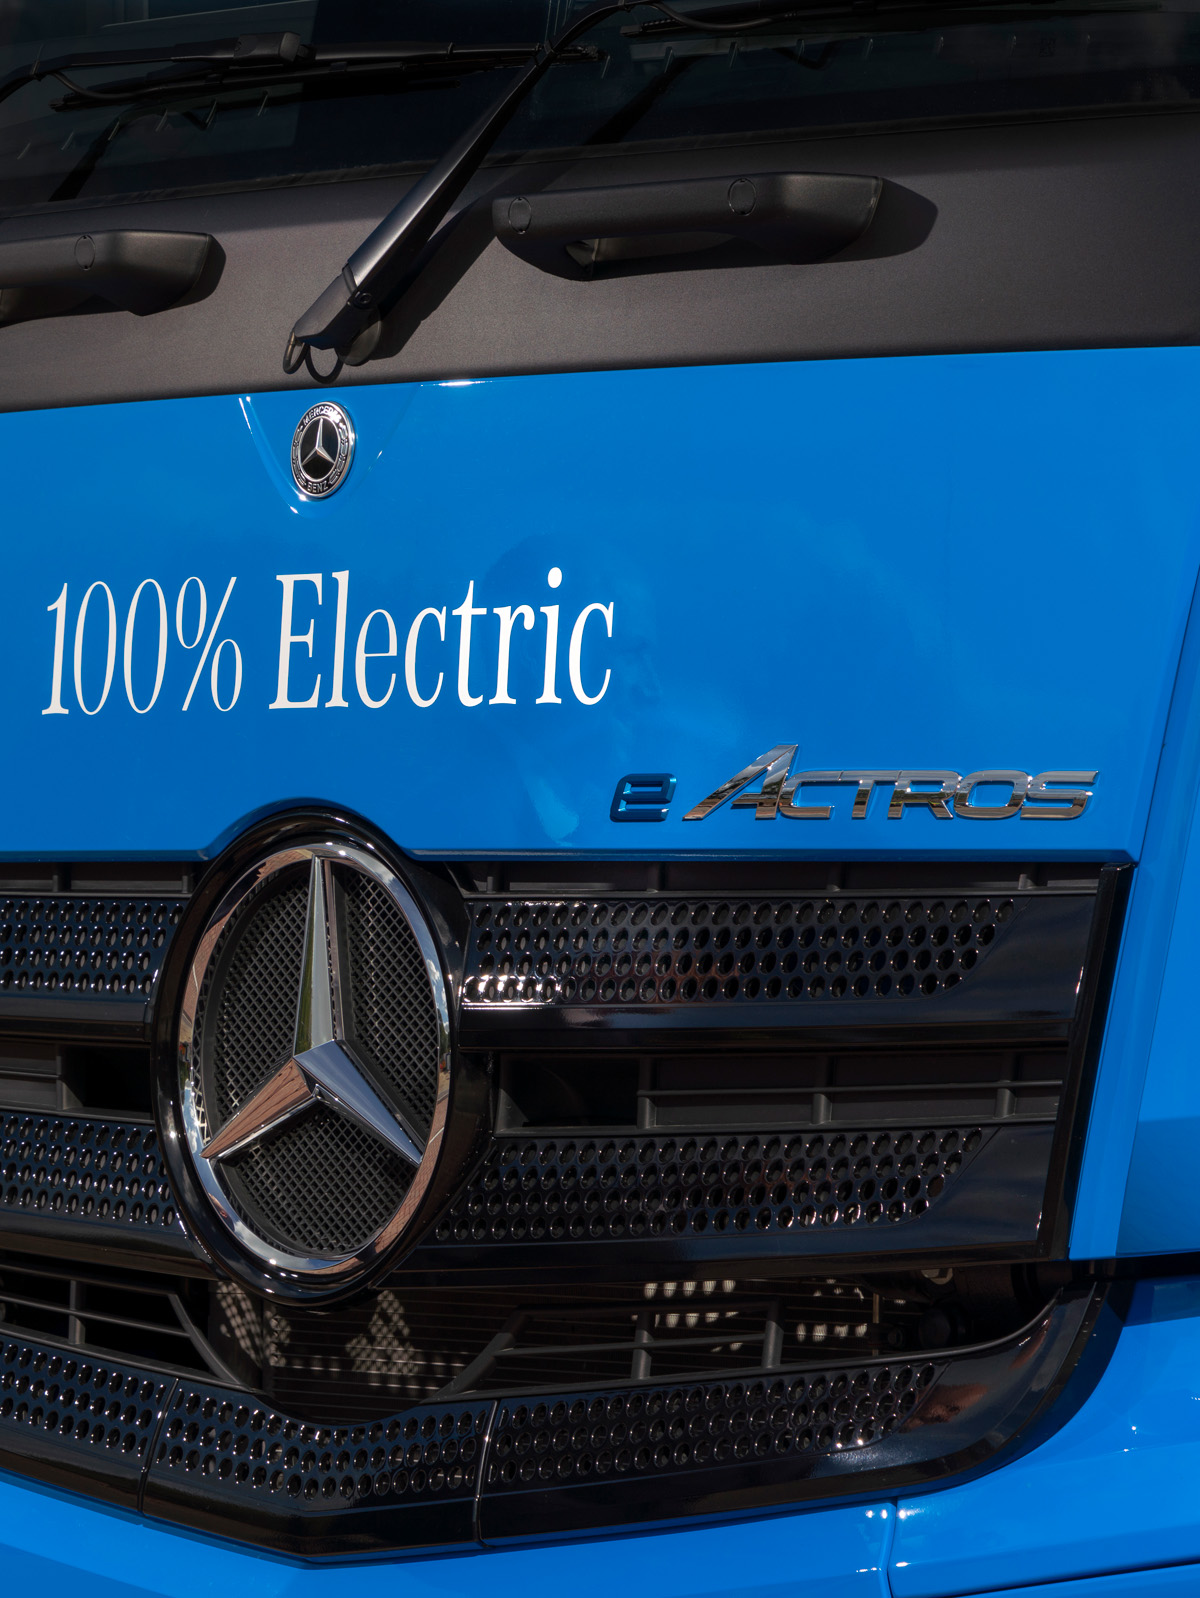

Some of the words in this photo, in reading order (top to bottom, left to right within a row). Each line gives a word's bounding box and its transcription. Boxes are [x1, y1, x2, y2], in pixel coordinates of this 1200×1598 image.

[302, 405, 342, 426] MERCED
[307, 480, 329, 493] BENZ
[41, 576, 243, 716] 100%
[268, 566, 615, 711] Electric
